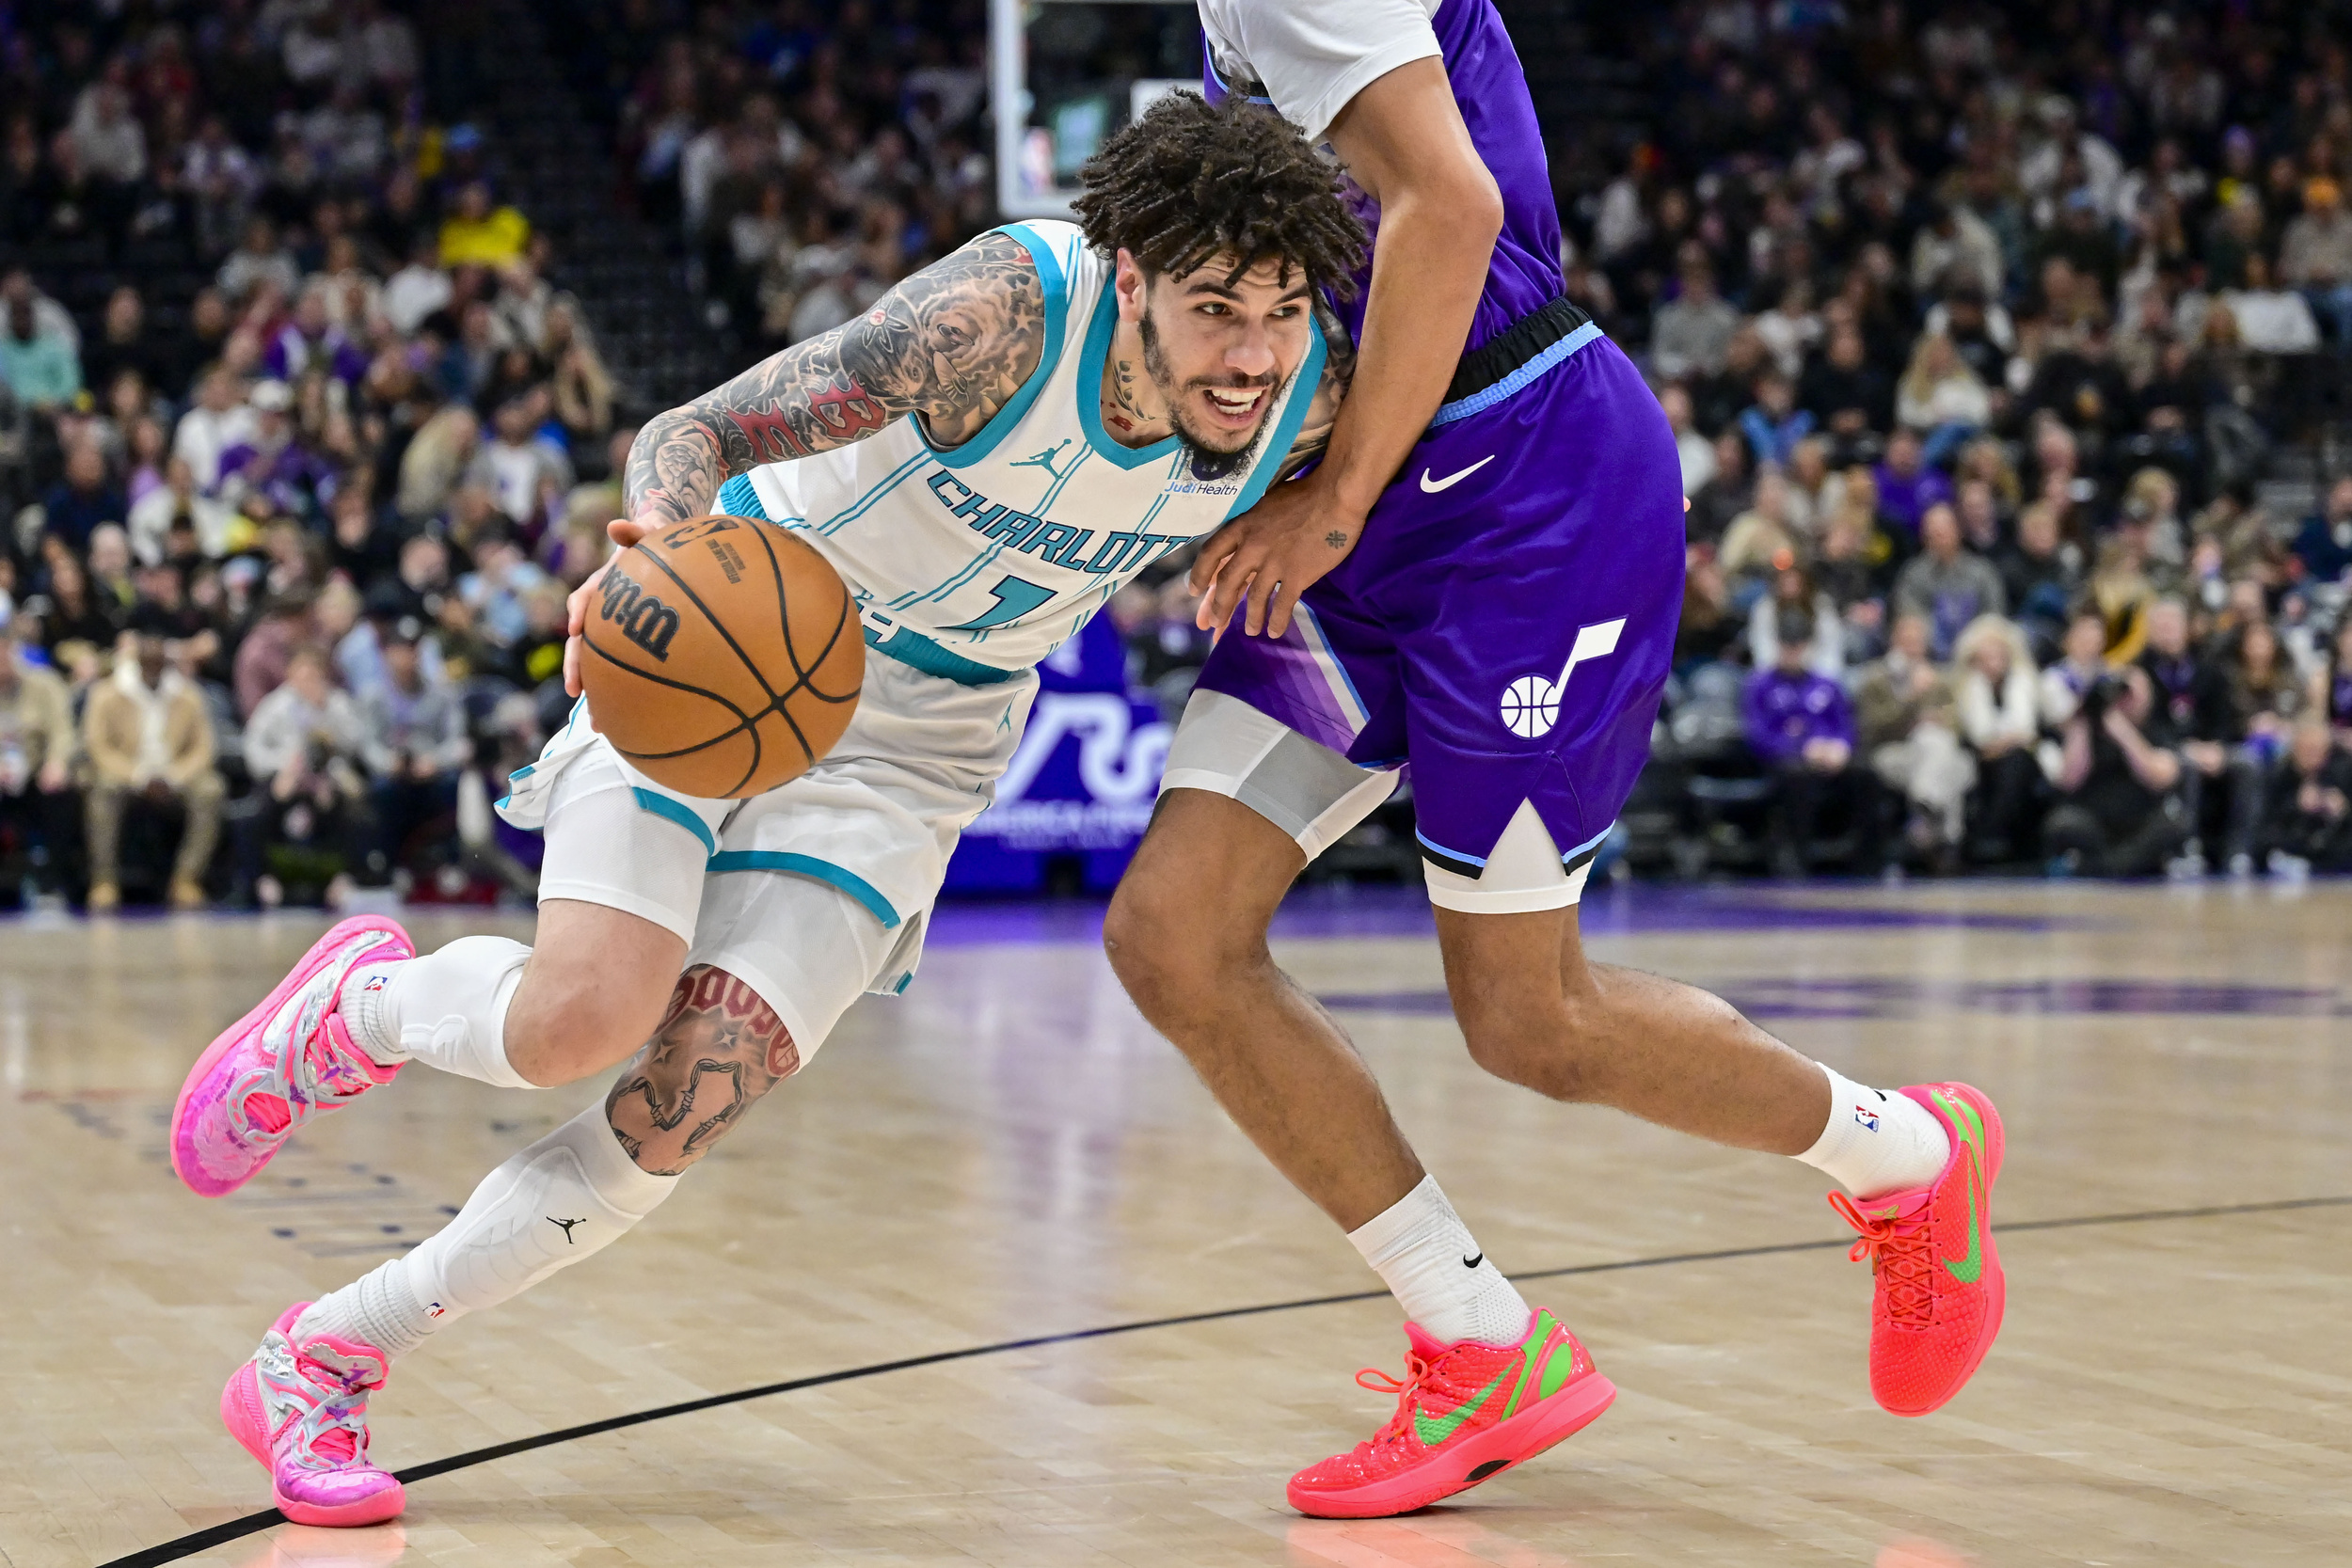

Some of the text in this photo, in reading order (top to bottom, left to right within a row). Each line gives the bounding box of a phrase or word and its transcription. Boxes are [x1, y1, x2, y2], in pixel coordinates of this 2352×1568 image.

[1165, 481, 1238, 496] Judi Health
[927, 468, 1201, 574] CHARLOTT
[933, 575, 1058, 631] 1
